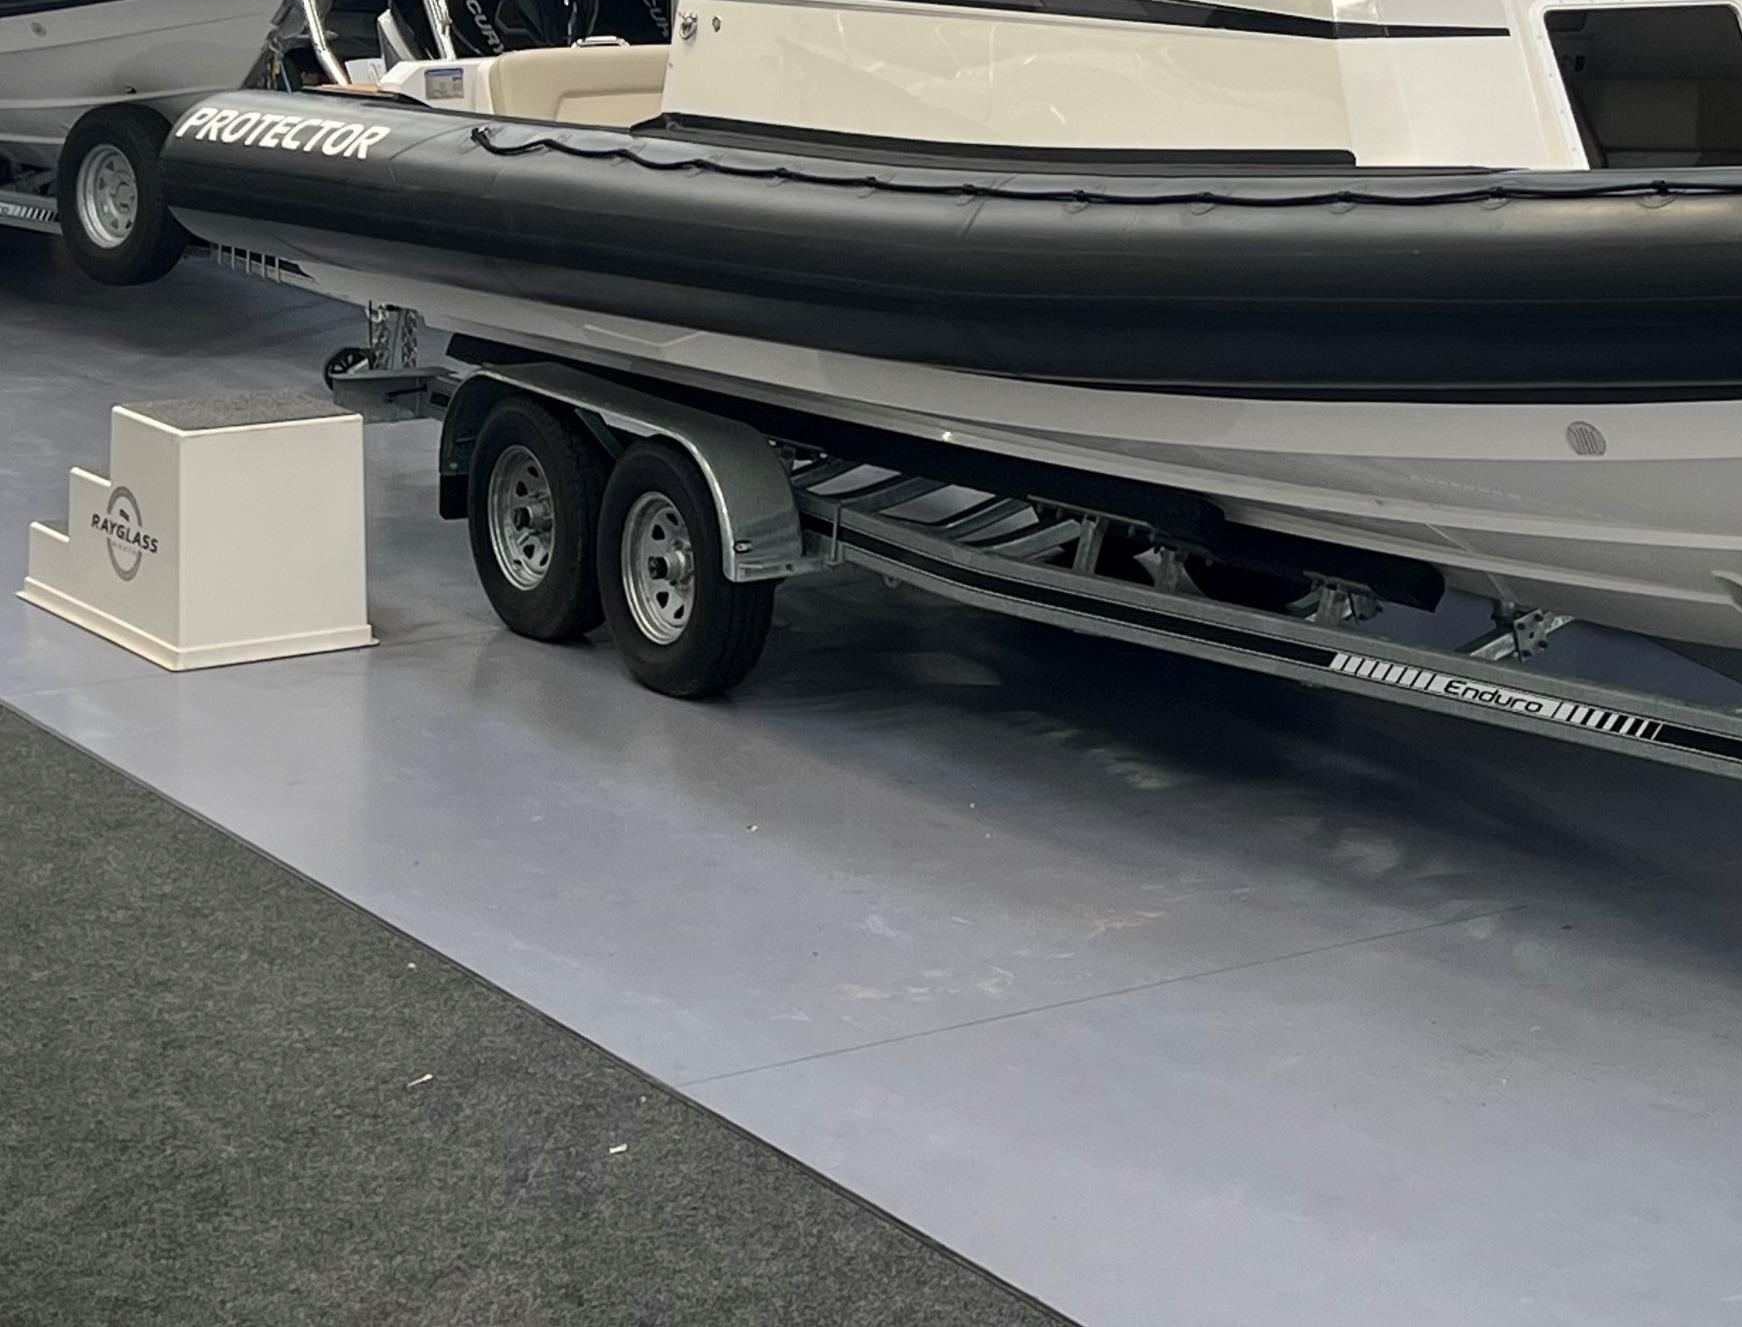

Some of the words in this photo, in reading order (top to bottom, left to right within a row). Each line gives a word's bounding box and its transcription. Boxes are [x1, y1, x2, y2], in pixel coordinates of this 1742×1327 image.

[176, 107, 391, 160] PROTECTOR
[91, 513, 159, 553] RAYGLASS
[1443, 678, 1543, 713] Enduro
